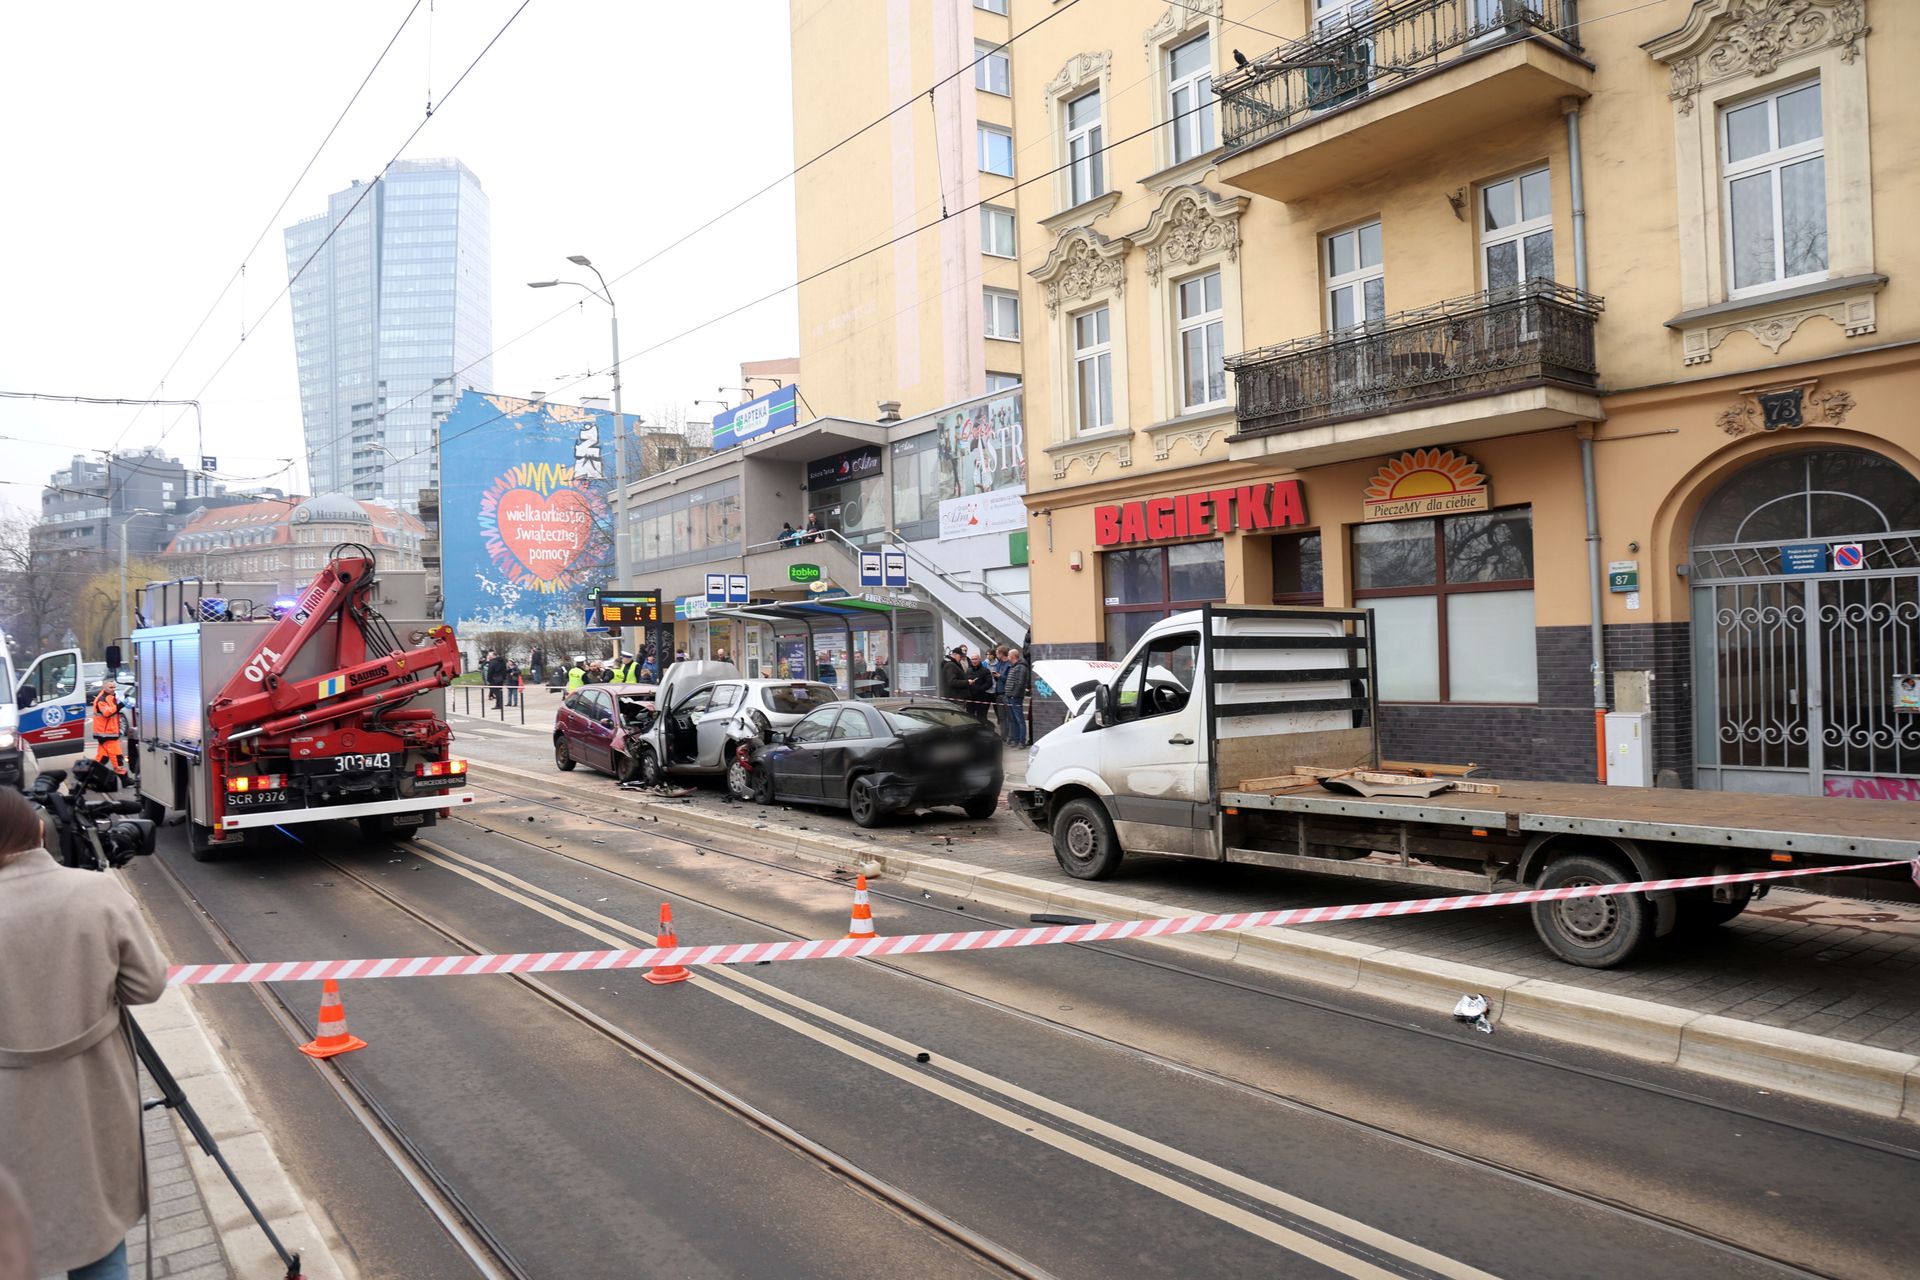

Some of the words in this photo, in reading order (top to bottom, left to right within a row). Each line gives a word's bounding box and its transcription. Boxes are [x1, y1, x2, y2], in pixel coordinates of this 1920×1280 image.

[744, 405, 768, 422] APTEKA
[1768, 398, 1797, 420] 73
[506, 503, 540, 522] wielka
[540, 504, 586, 524] orkiestra
[1094, 480, 1306, 546] BAGIETKA
[1373, 500, 1422, 517] PieczeMY
[1426, 498, 1442, 511] dla
[1445, 494, 1477, 509] ciebie
[515, 523, 580, 549] świątecznej
[529, 544, 570, 565] pomocy
[791, 567, 819, 577] żabka
[1615, 575, 1629, 585] 87
[244, 646, 282, 682] 071
[350, 665, 390, 686] SAURUS
[415, 776, 465, 788] MERCEDES-BENZ
[228, 794, 253, 806] SCR
[258, 791, 285, 803] 9376
